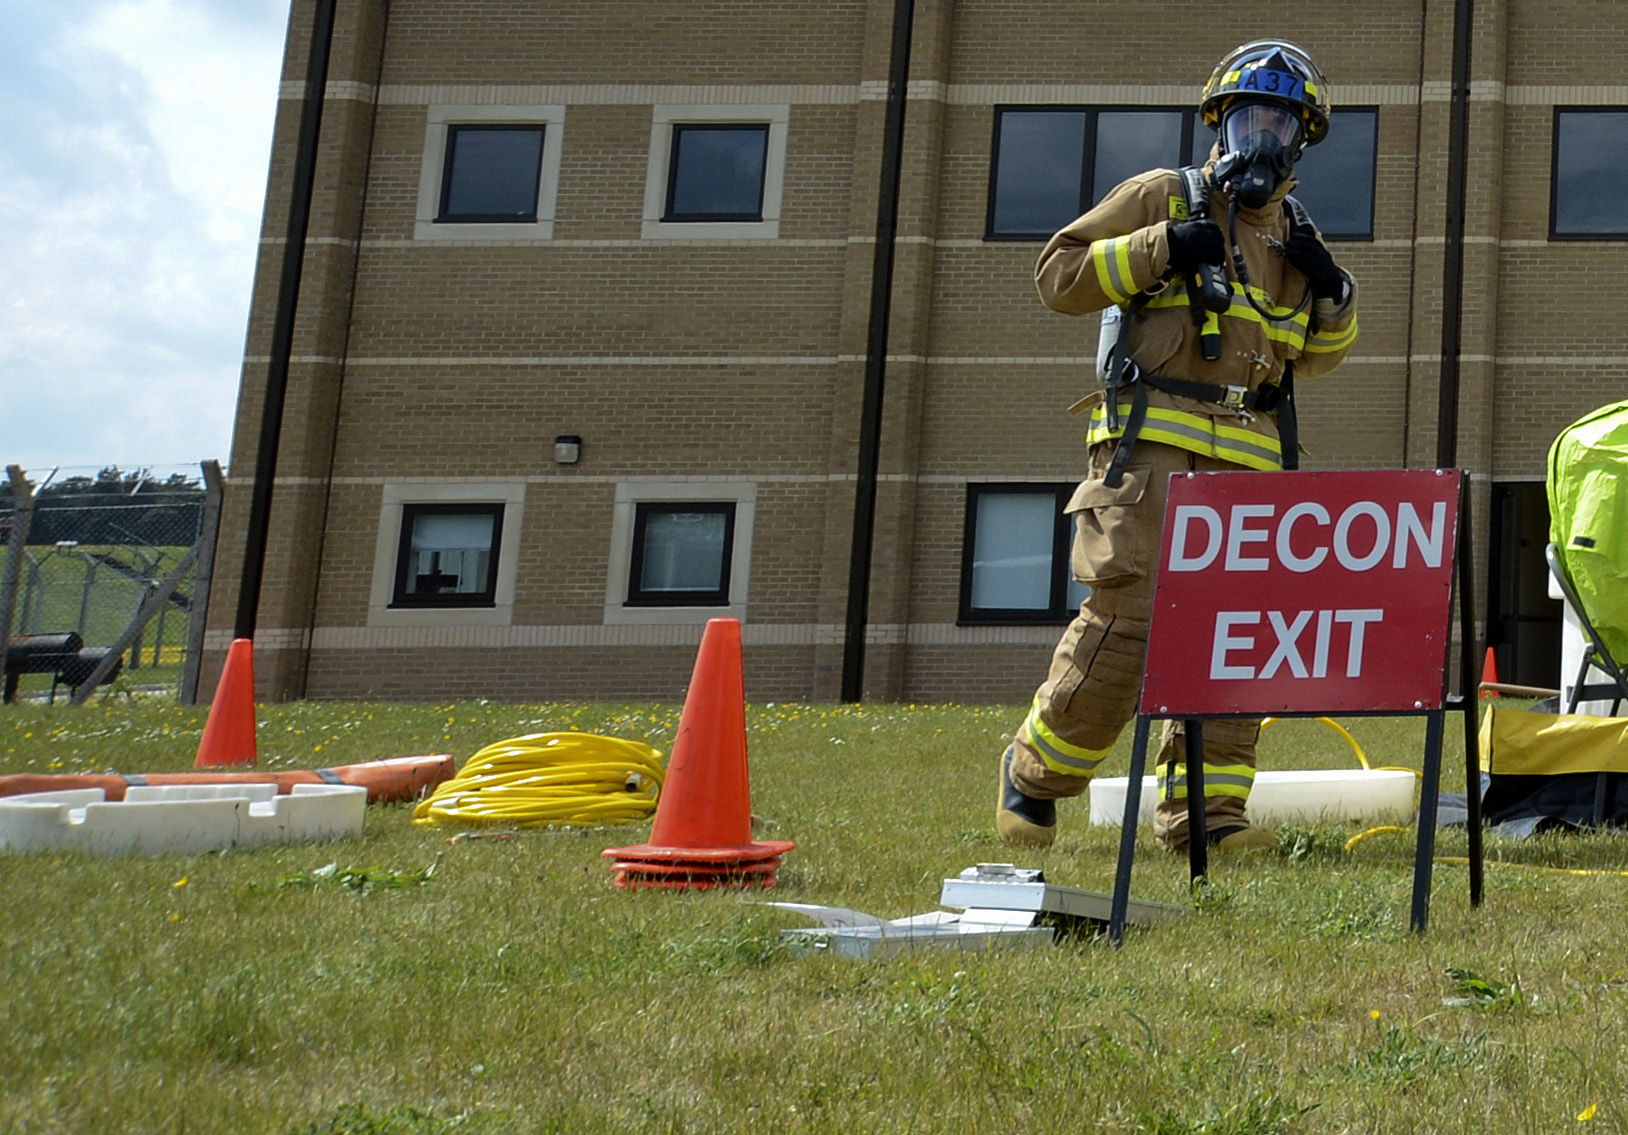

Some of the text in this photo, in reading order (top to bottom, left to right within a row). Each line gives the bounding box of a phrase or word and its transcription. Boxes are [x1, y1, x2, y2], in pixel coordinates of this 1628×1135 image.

[1244, 69, 1299, 96] A37
[1168, 500, 1447, 573] DECON
[1209, 608, 1384, 680] EXIT
